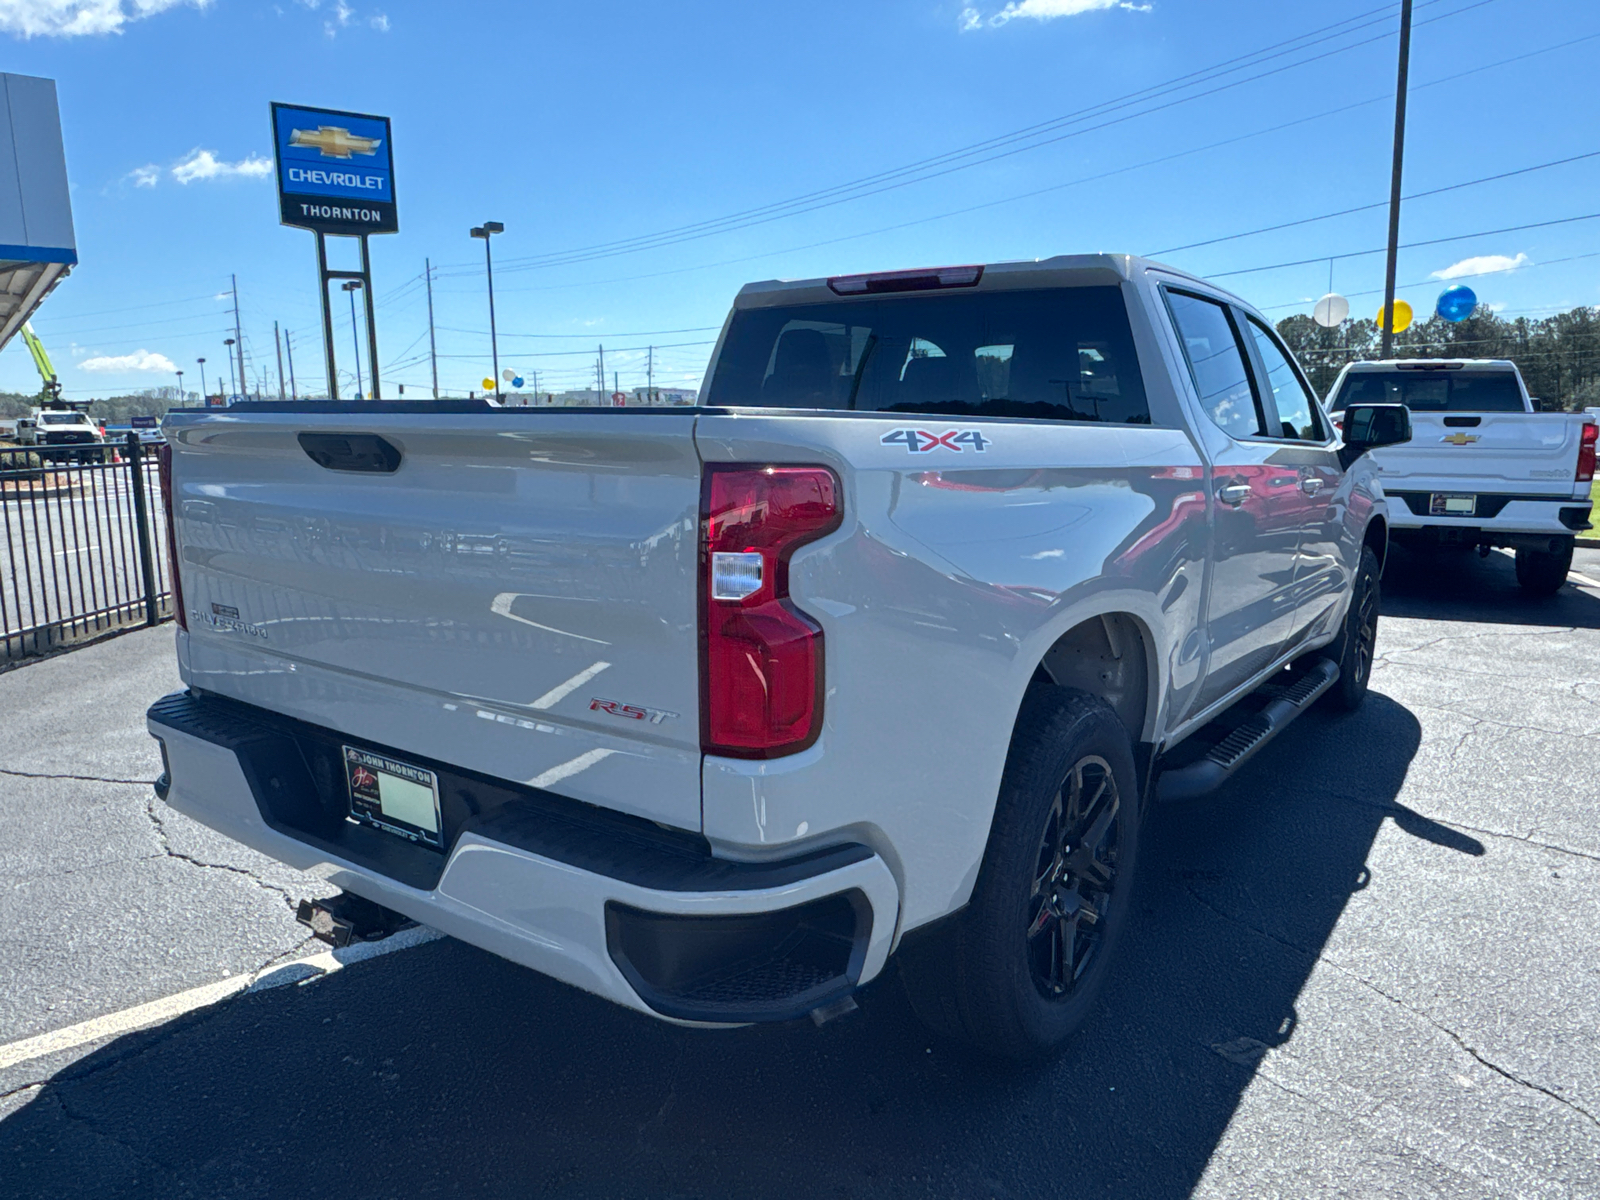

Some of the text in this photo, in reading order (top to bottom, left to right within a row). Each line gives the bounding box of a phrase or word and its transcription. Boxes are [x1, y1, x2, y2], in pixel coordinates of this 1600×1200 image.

[288, 168, 384, 190] CHEVROLET
[300, 204, 381, 222] THORNTON
[588, 697, 680, 725] RST
[362, 754, 384, 769] JOHN
[385, 761, 431, 783] THORNTON
